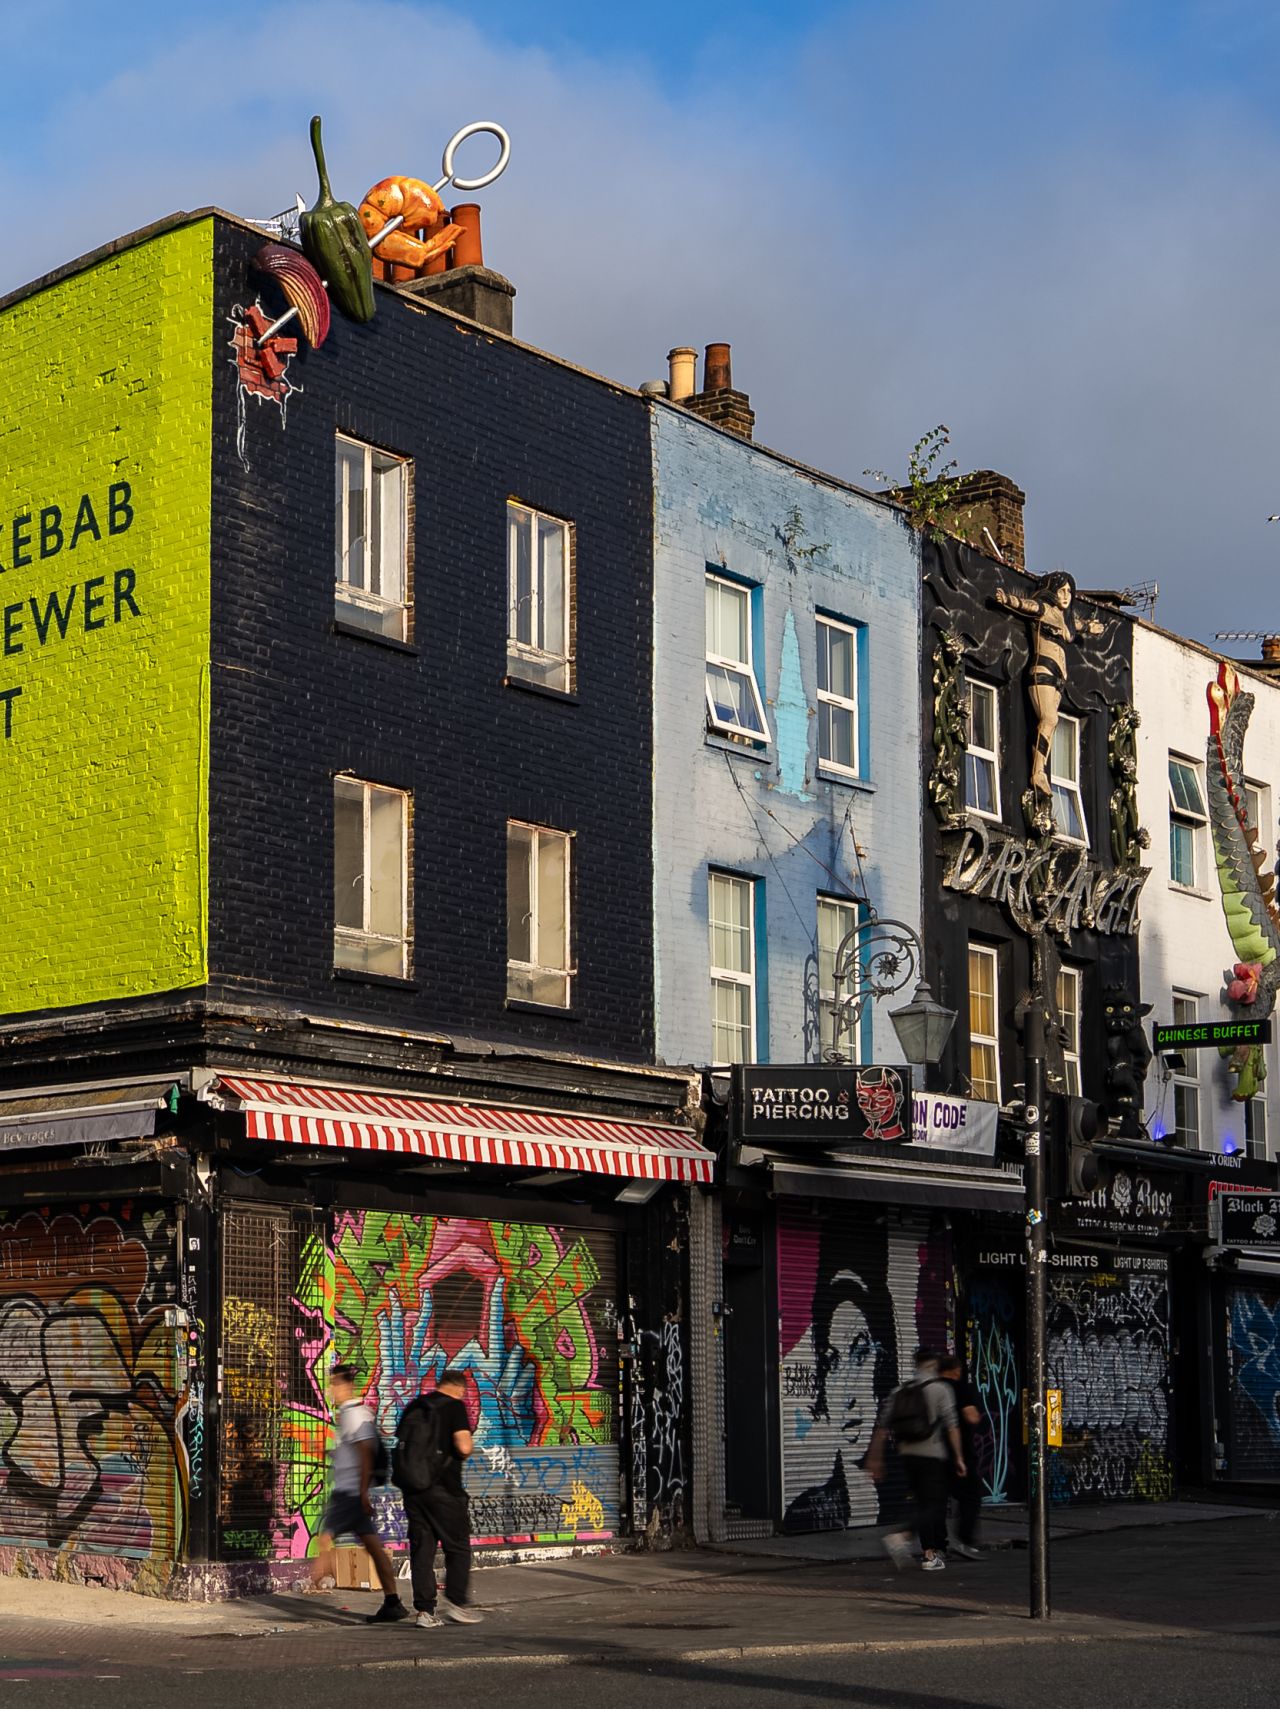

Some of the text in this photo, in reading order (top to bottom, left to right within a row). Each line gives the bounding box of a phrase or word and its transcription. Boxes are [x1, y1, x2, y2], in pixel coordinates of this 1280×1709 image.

[1157, 1024, 1260, 1043] CHINESE BUFFET
[751, 1088, 830, 1103] TATTOO
[752, 1104, 850, 1121] PIERCING
[933, 1101, 967, 1130] CODE
[3, 1128, 56, 1145] Beverages
[1217, 1155, 1241, 1168] ORIENT
[1135, 1176, 1172, 1217] Rose
[1227, 1197, 1264, 1213] Black
[979, 1252, 1017, 1265] LIGHT
[1113, 1256, 1168, 1271] LIGHT UP T-SHIRTS
